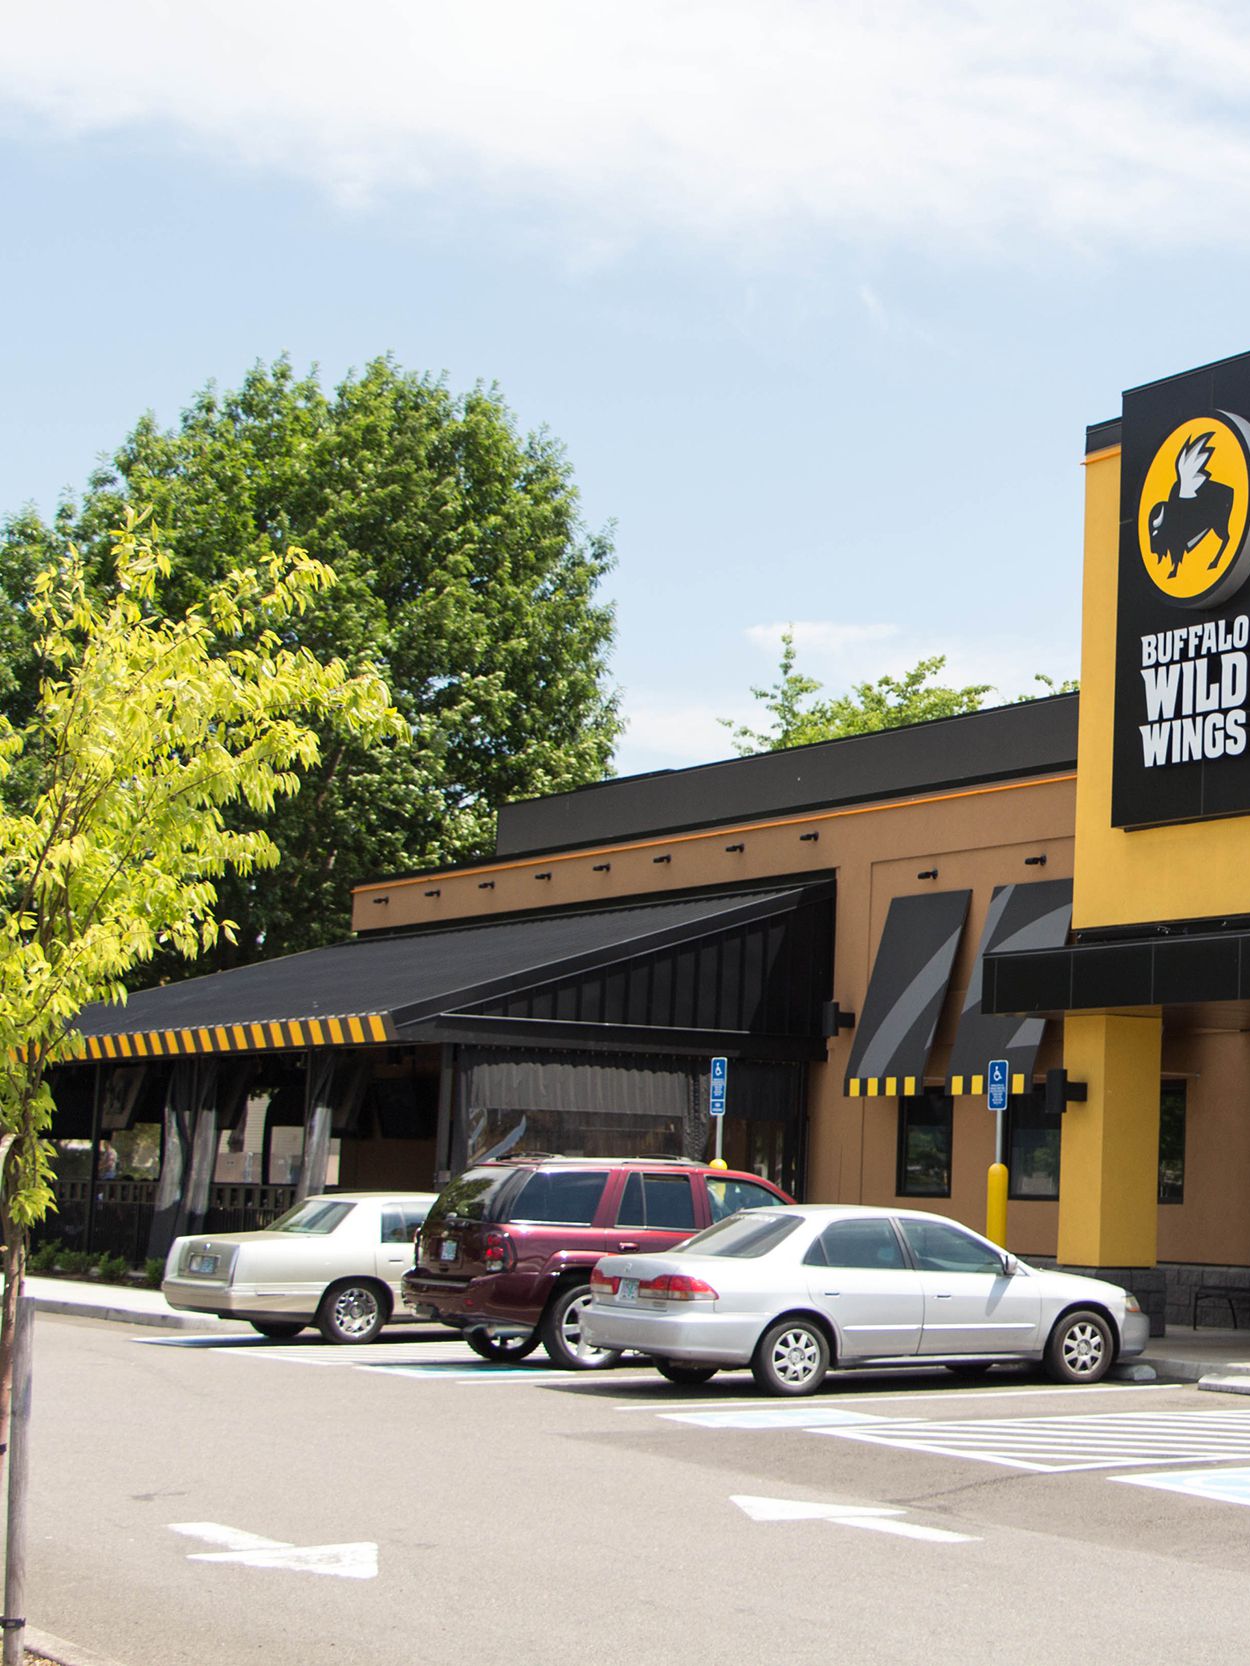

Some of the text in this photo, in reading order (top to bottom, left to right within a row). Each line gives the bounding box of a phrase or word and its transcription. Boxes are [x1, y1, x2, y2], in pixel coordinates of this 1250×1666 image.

[1140, 614, 1250, 667] BUFFALO
[1140, 651, 1248, 722] WILD
[1138, 708, 1247, 768] WINGS
